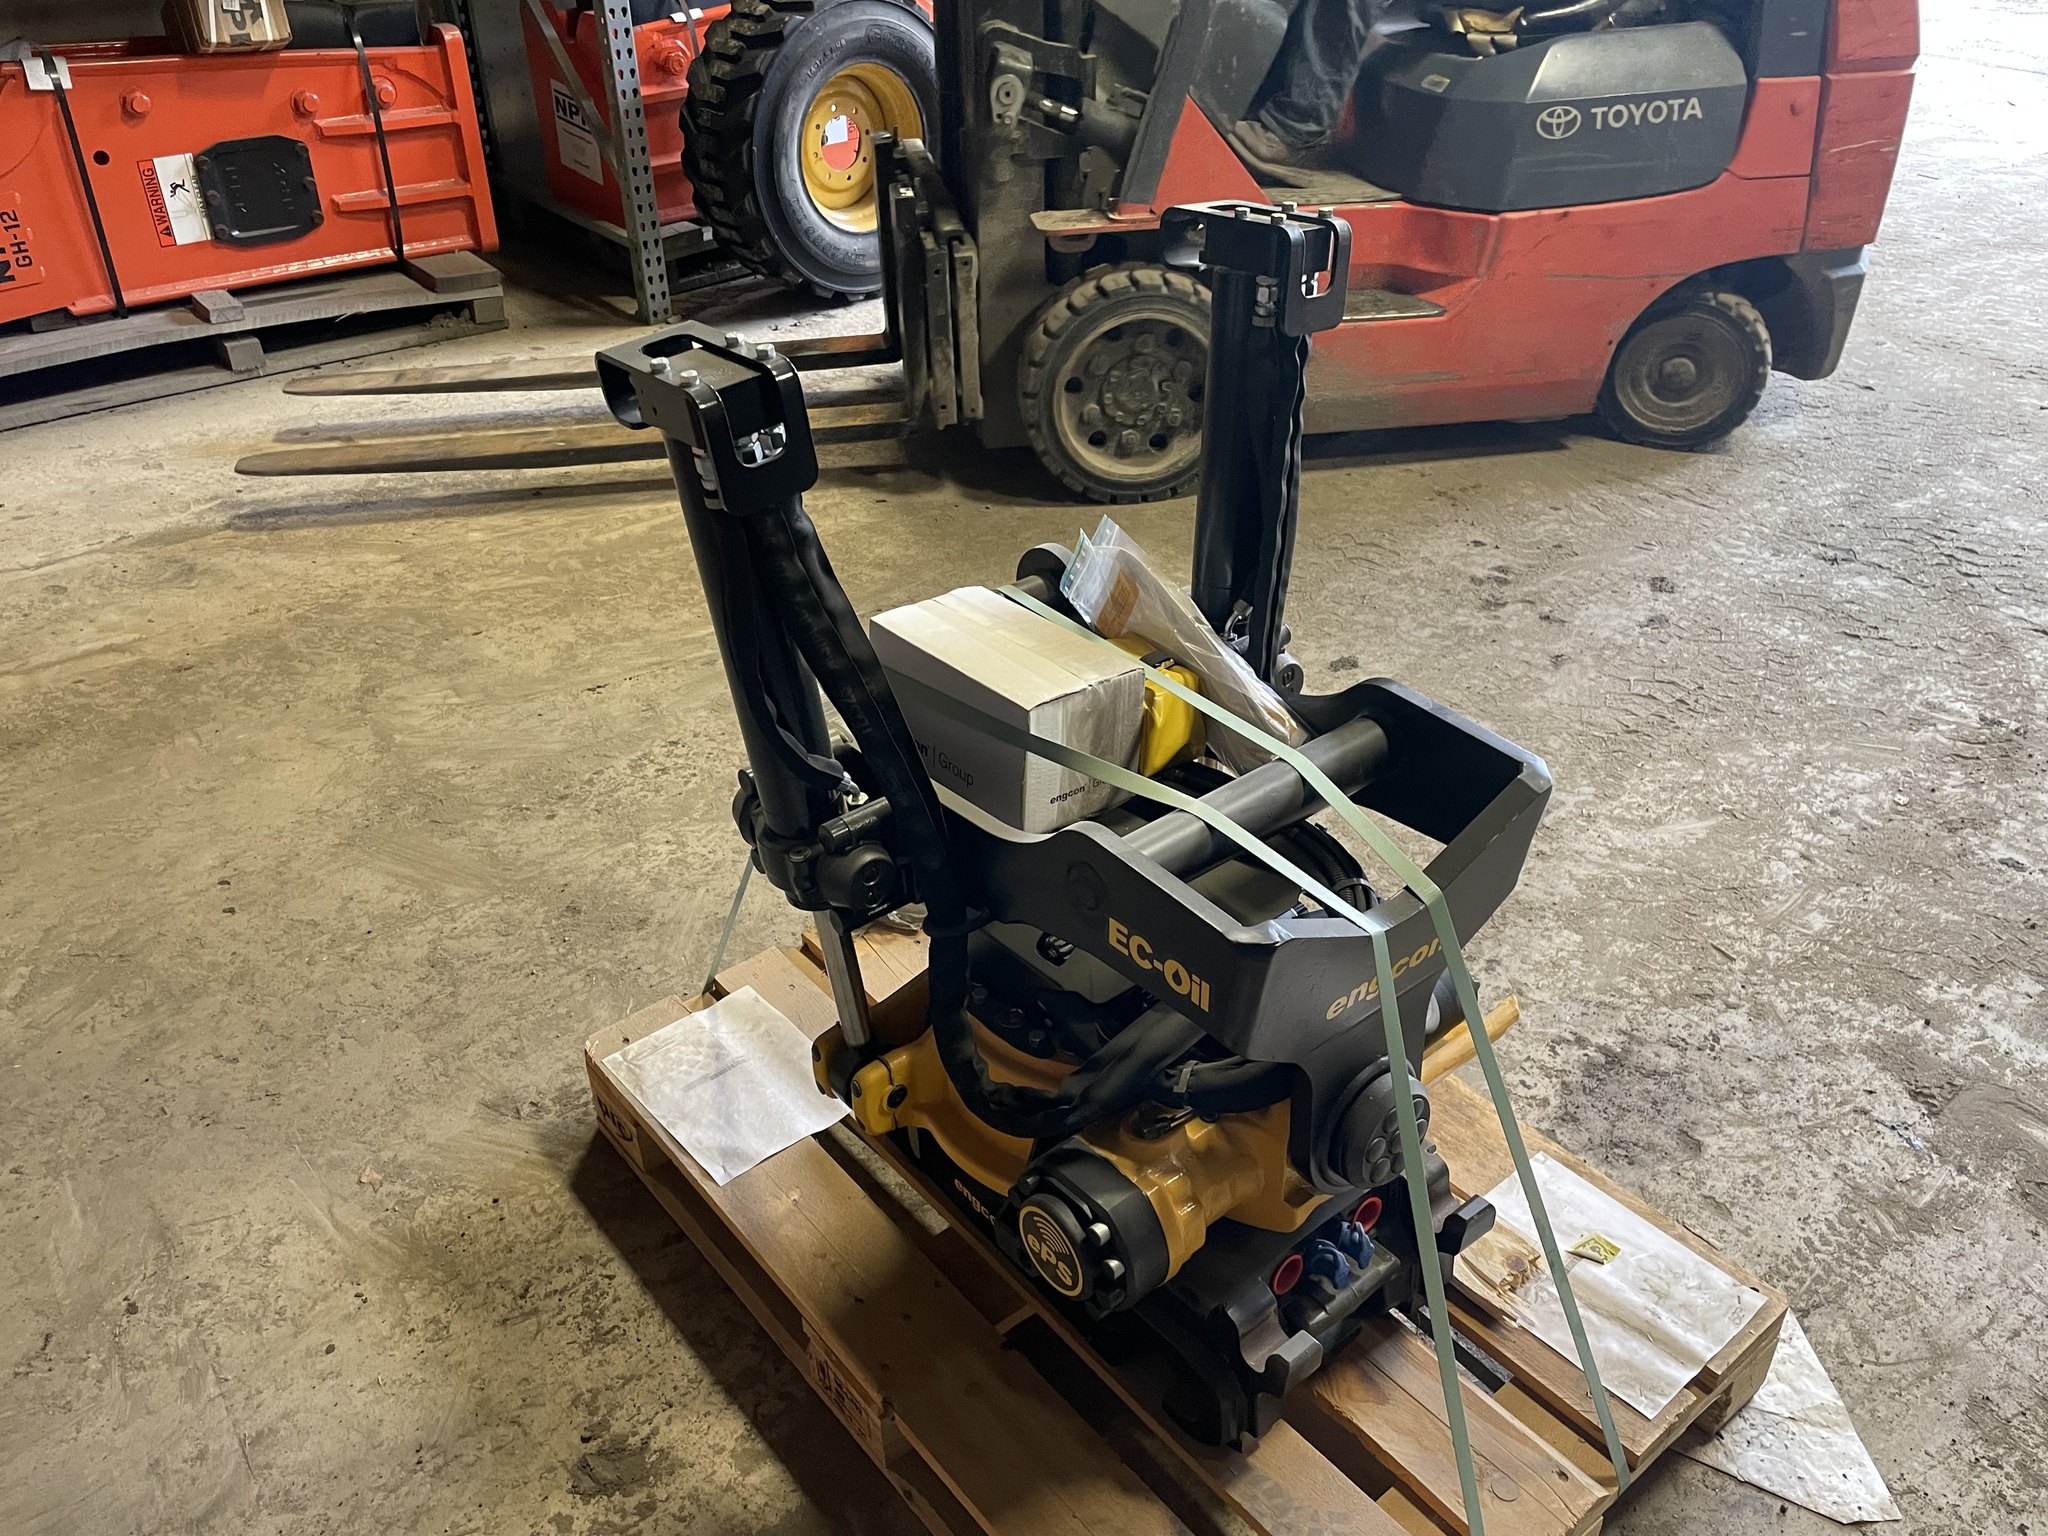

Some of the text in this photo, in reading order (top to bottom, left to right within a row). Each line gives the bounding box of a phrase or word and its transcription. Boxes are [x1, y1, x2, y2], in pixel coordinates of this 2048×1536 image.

[554, 94, 587, 127] NP
[1591, 97, 1703, 130] TOYOTA
[142, 167, 168, 226] WARNING
[0, 209, 33, 268] GH-12
[938, 752, 975, 789] Group
[1050, 784, 1087, 805] engcon
[1108, 917, 1211, 1014] EC-Oil
